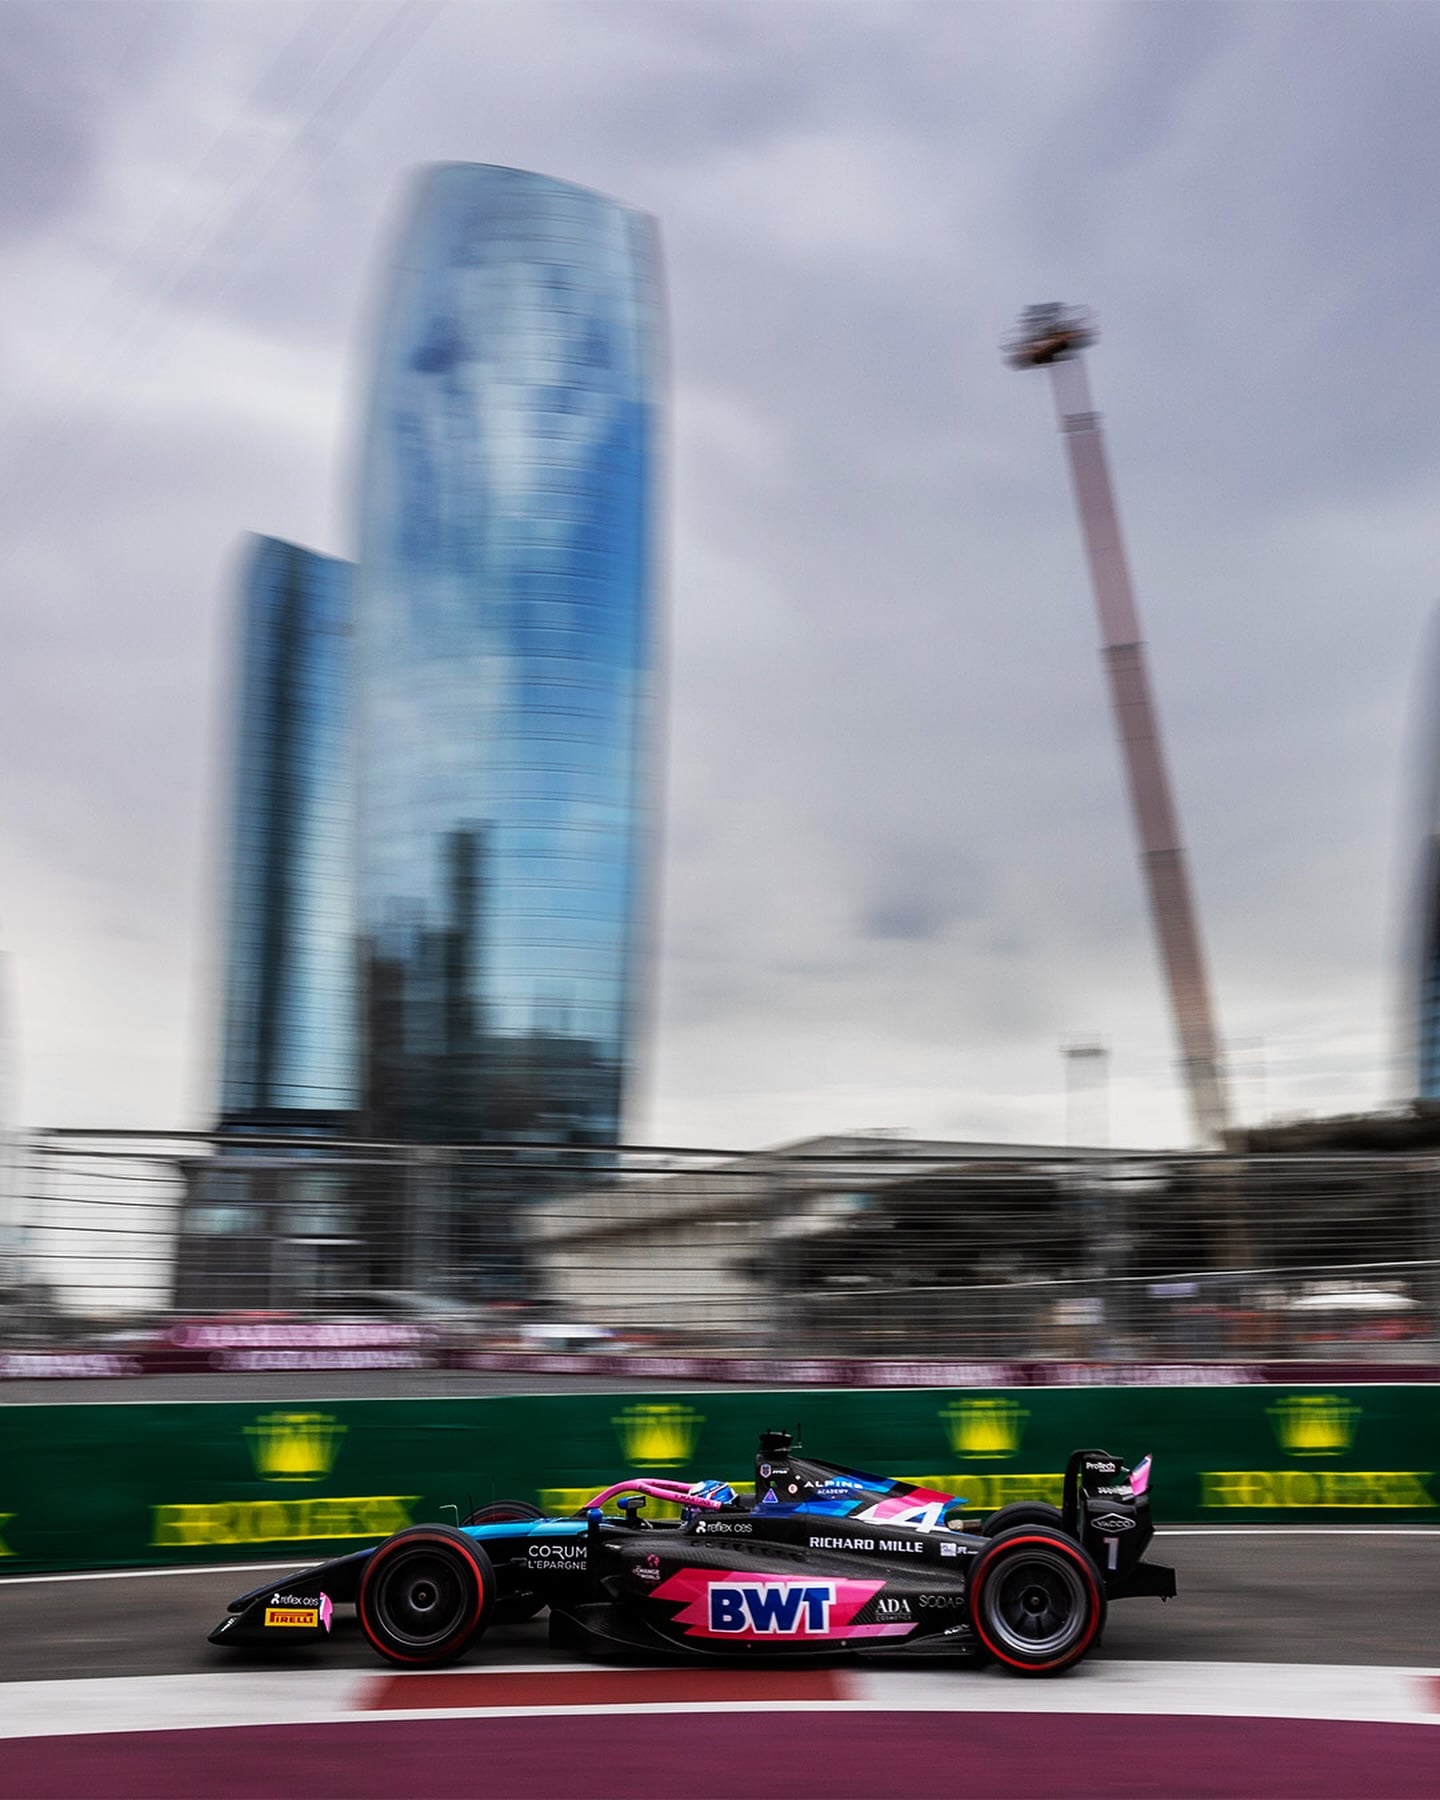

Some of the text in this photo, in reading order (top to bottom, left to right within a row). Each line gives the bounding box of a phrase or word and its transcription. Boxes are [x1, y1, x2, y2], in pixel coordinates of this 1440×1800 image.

[707, 1521, 733, 1533] reflex
[809, 1537, 924, 1553] RICHARD MILLE
[528, 1545, 587, 1560] CORUM
[1104, 1537, 1119, 1570] 1
[528, 1560, 587, 1570] L'EPARGNE
[708, 1582, 836, 1634] BWT
[875, 1600, 912, 1613] ADA
[270, 1611, 314, 1623] PIRELLI
